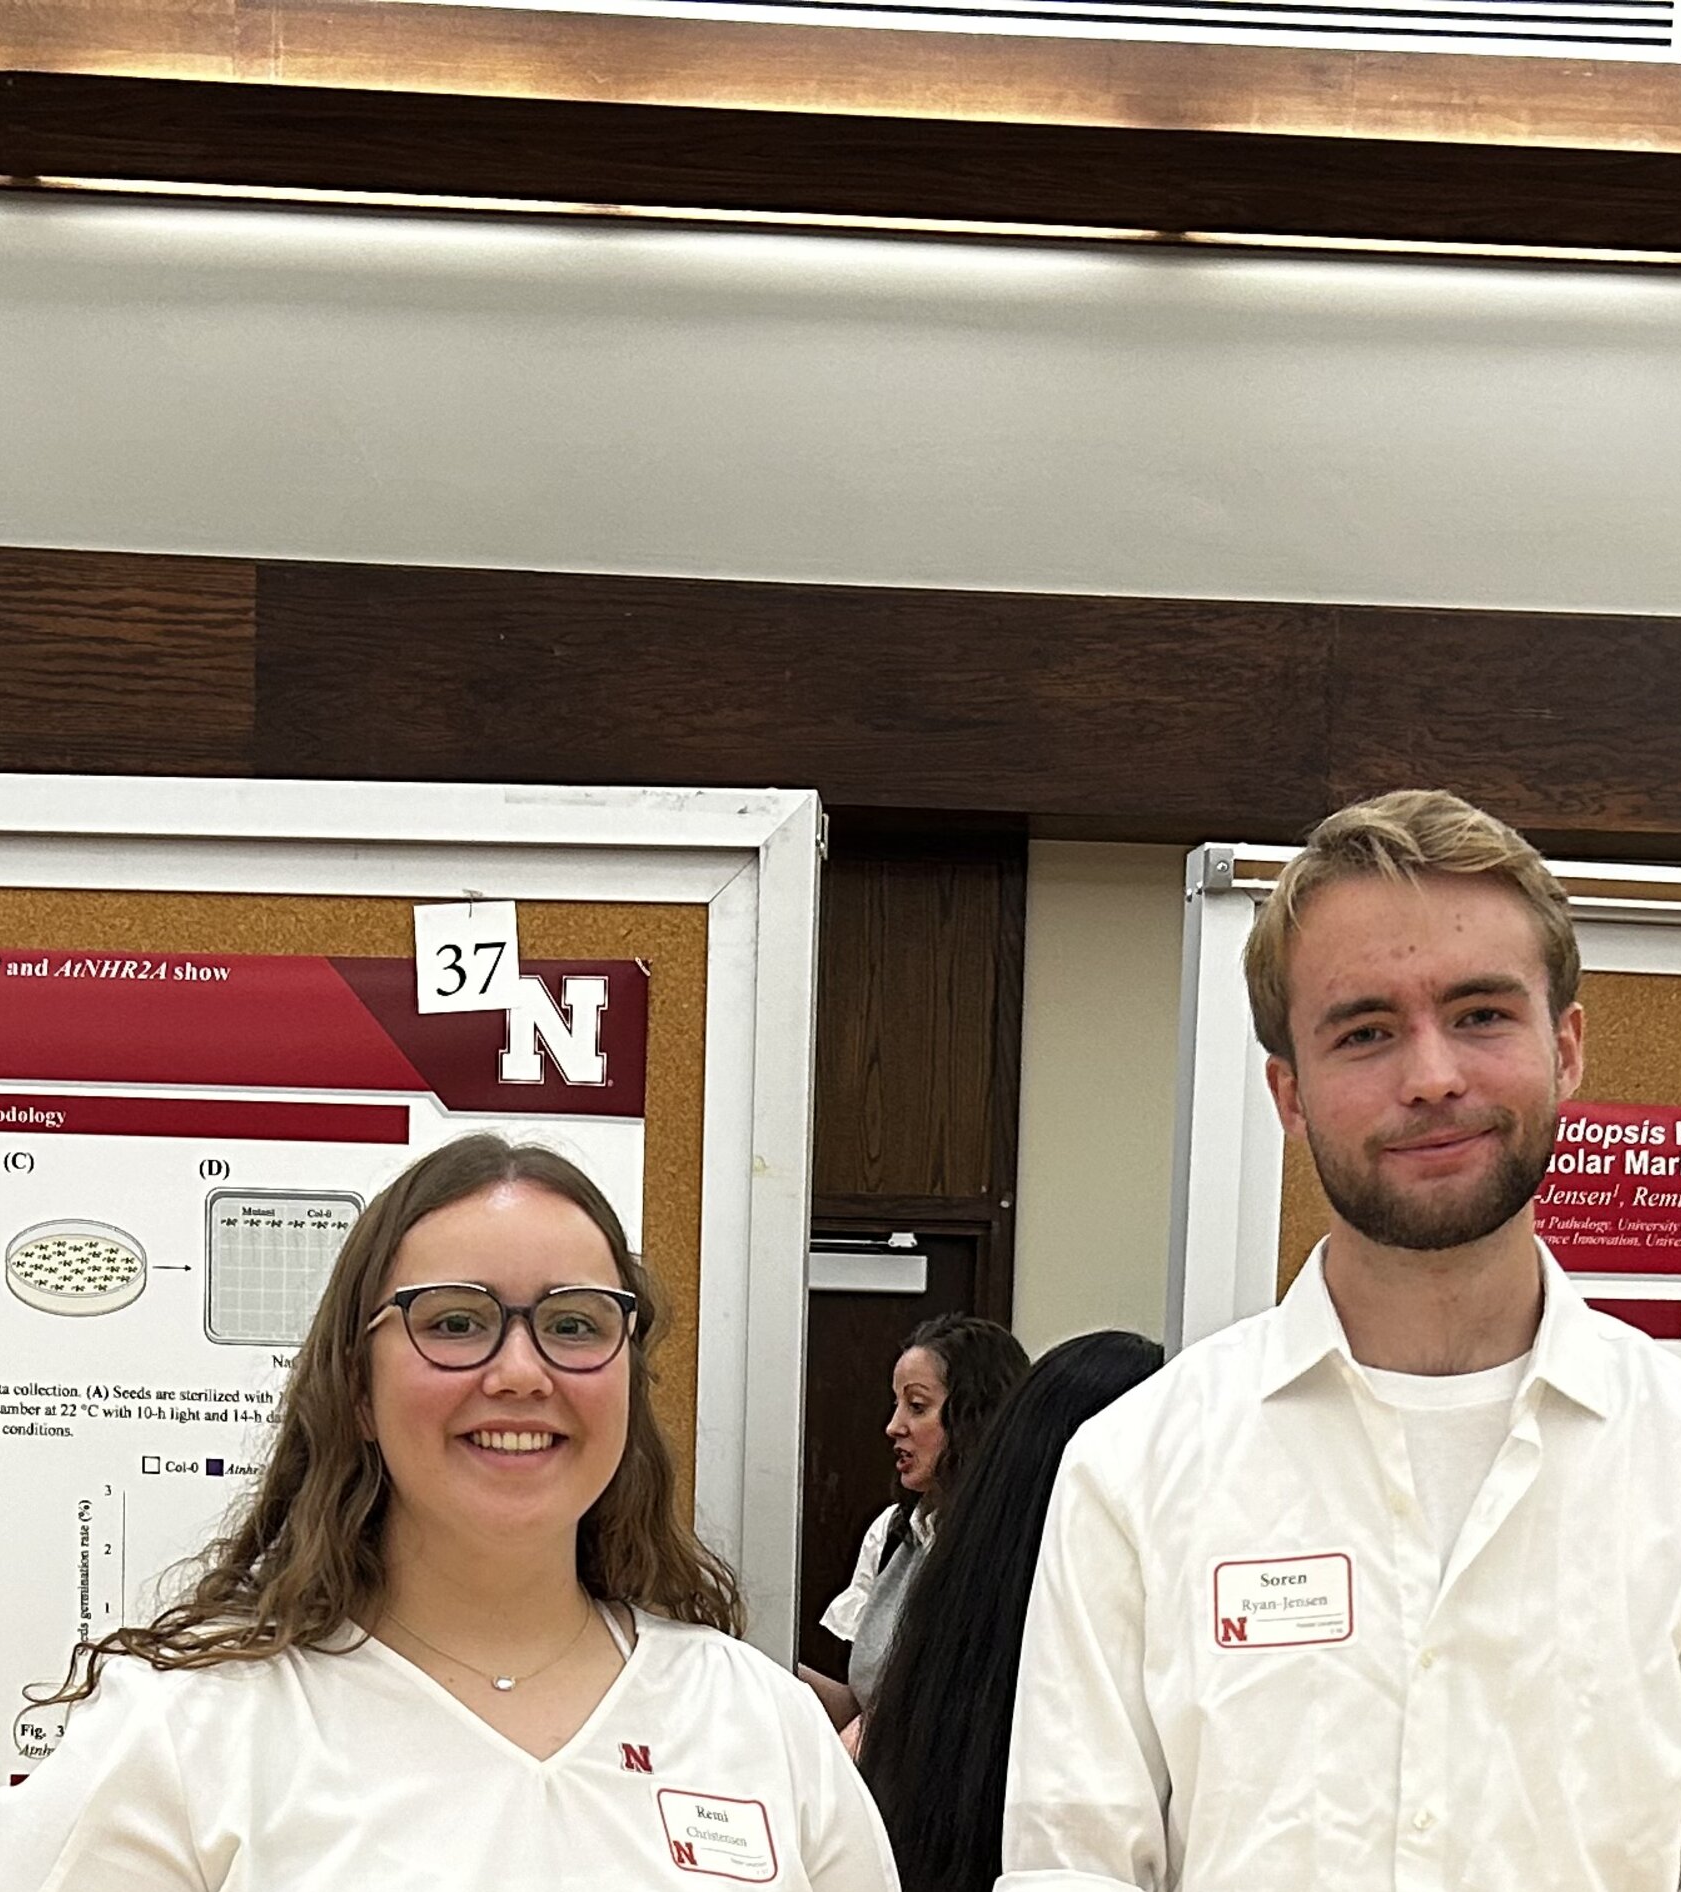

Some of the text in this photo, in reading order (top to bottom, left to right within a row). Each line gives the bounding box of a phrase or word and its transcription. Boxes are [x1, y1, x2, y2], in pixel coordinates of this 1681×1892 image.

[6, 958, 48, 976] and
[53, 959, 166, 979] AtNHR2A
[173, 962, 230, 980] show
[436, 942, 506, 996] 37
[498, 974, 609, 1087] N
[1556, 1118, 1665, 1146] idopsis
[4, 1152, 33, 1172] (C)
[199, 1159, 229, 1179] (D)
[1260, 1573, 1308, 1587] Soren
[1242, 1594, 1328, 1612] Ryan-Jensen
[1221, 1617, 1248, 1642] N
[621, 1743, 653, 1774] N
[695, 1805, 729, 1823] Remi
[672, 1841, 698, 1866] N
